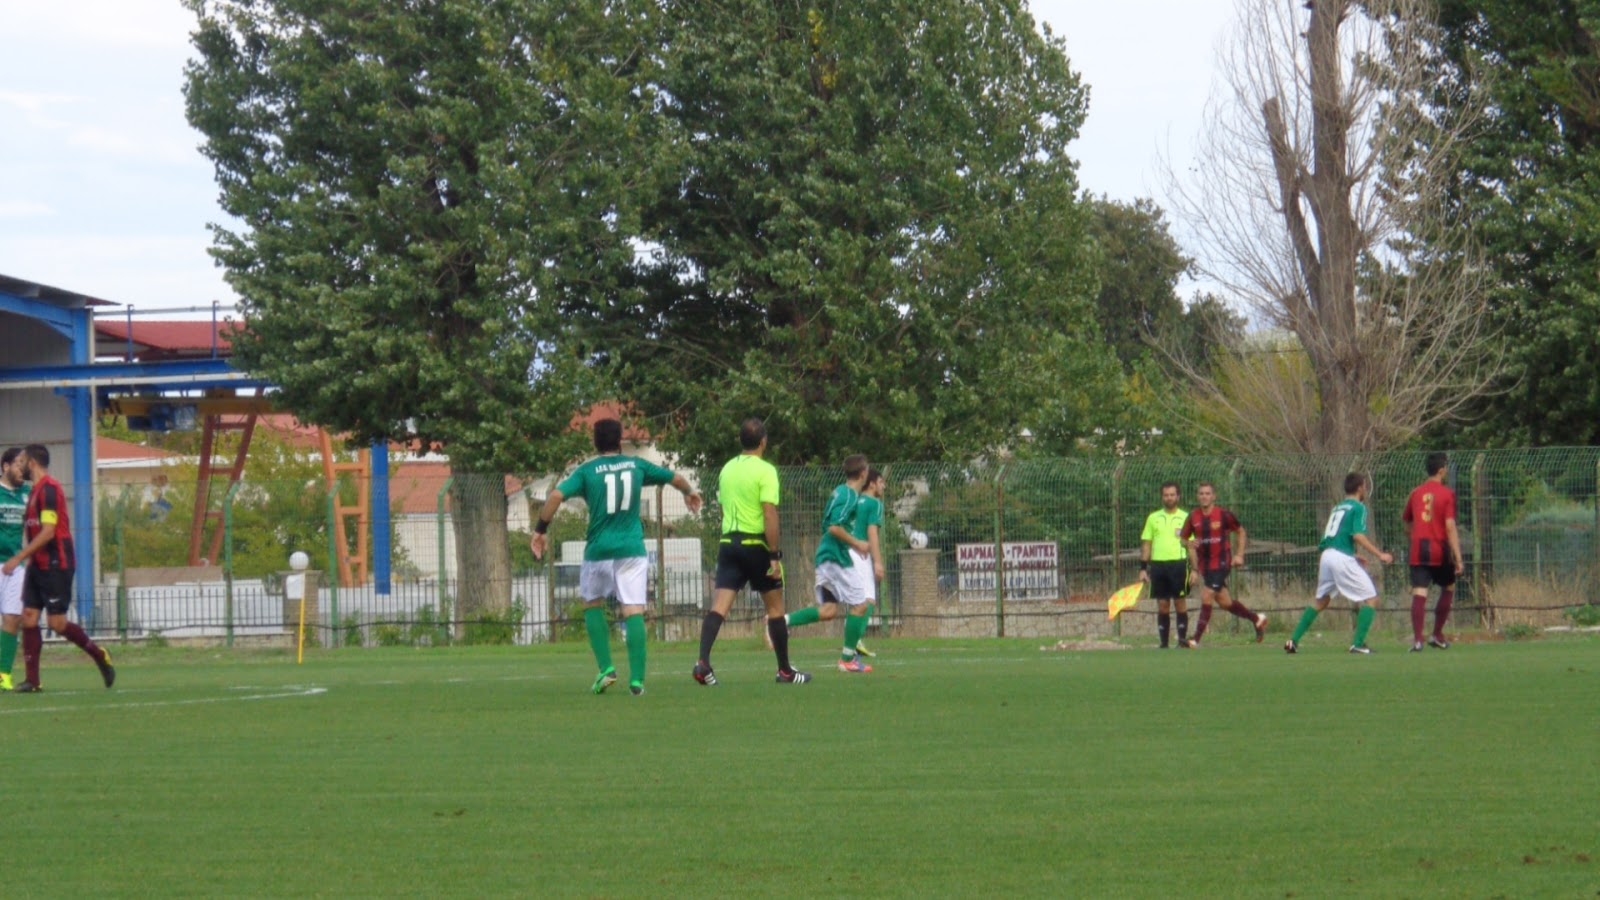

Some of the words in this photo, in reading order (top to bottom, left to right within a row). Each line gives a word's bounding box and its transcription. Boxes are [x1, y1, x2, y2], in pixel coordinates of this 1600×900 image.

[604, 470, 632, 514] 11
[1421, 492, 1434, 523] 3
[960, 546, 1005, 560] ΜΑΡΜΑ
[1012, 544, 1055, 559] ΓΡΑΝΙΤΕΣ
